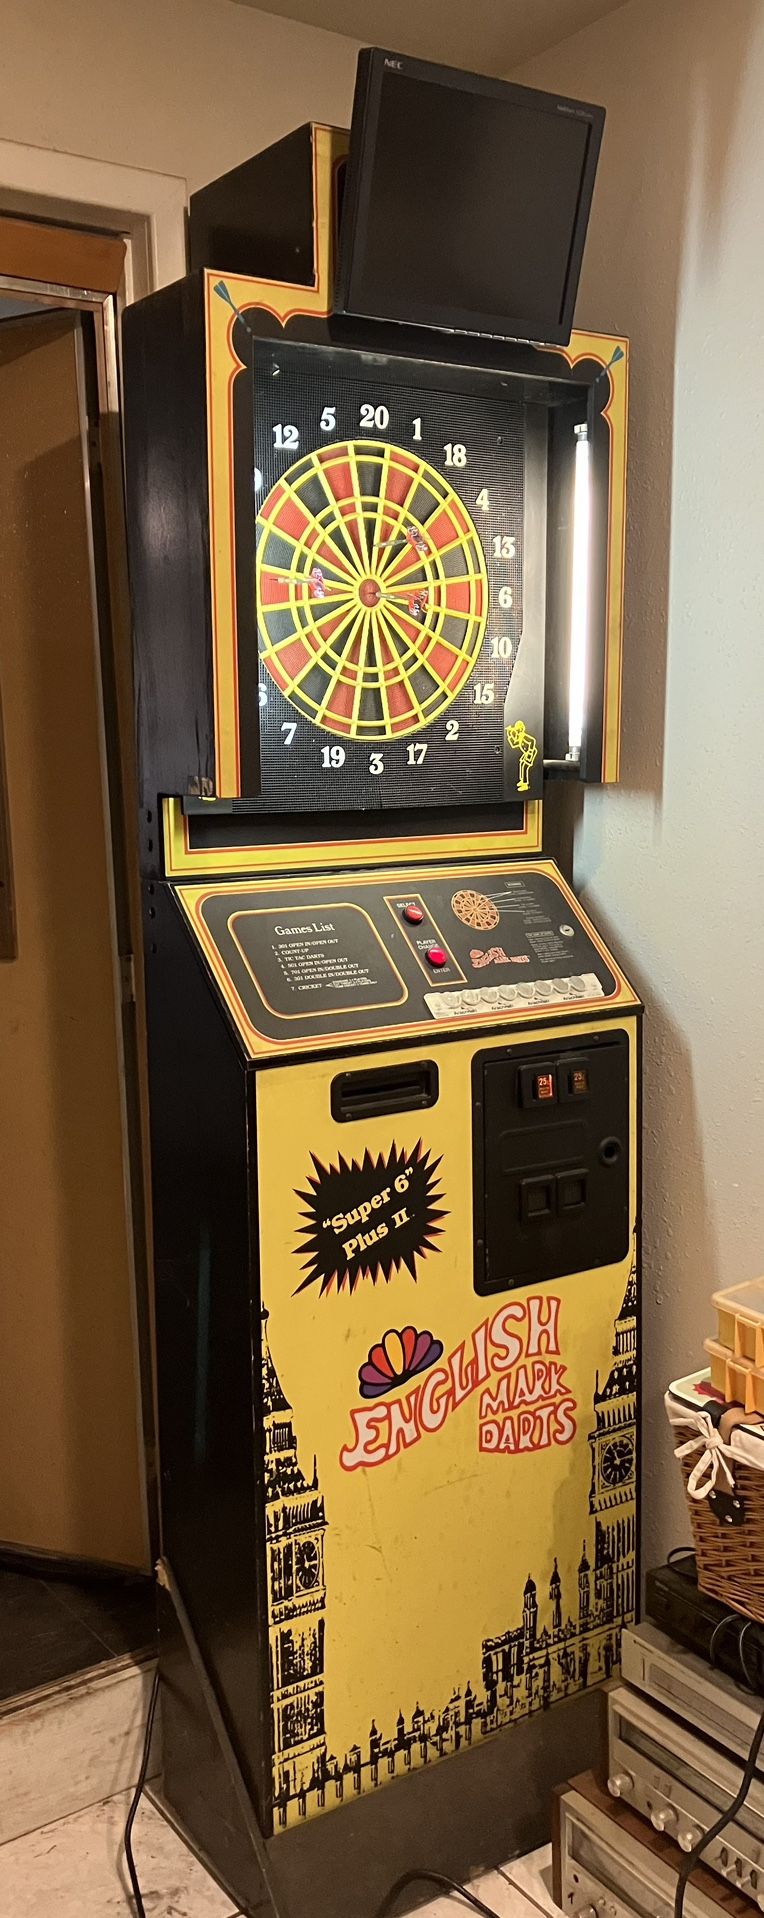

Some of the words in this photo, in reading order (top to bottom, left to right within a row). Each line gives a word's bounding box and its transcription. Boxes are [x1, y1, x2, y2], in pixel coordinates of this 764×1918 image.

[384, 58, 404, 70] NEC
[320, 406, 336, 431] 5
[358, 403, 390, 430] 20
[272, 423, 299, 449] 12
[411, 417, 423, 441] 1
[443, 442, 468, 467] 18
[475, 488, 490, 511] 4
[492, 535, 516, 558] 13
[498, 586, 513, 608] 6
[490, 636, 513, 659] 10
[473, 683, 495, 705] 15
[280, 722, 298, 745] 7
[445, 719, 460, 741] 2
[320, 745, 346, 768] 19
[368, 752, 385, 775] 3
[406, 743, 428, 765] 17
[274, 925, 313, 936] Games
[312, 922, 336, 933] List
[341, 1222, 389, 1261] Plus
[339, 1295, 562, 1472] ENGLISH
[479, 1360, 573, 1420] MARK
[479, 1397, 577, 1455] DARTS
